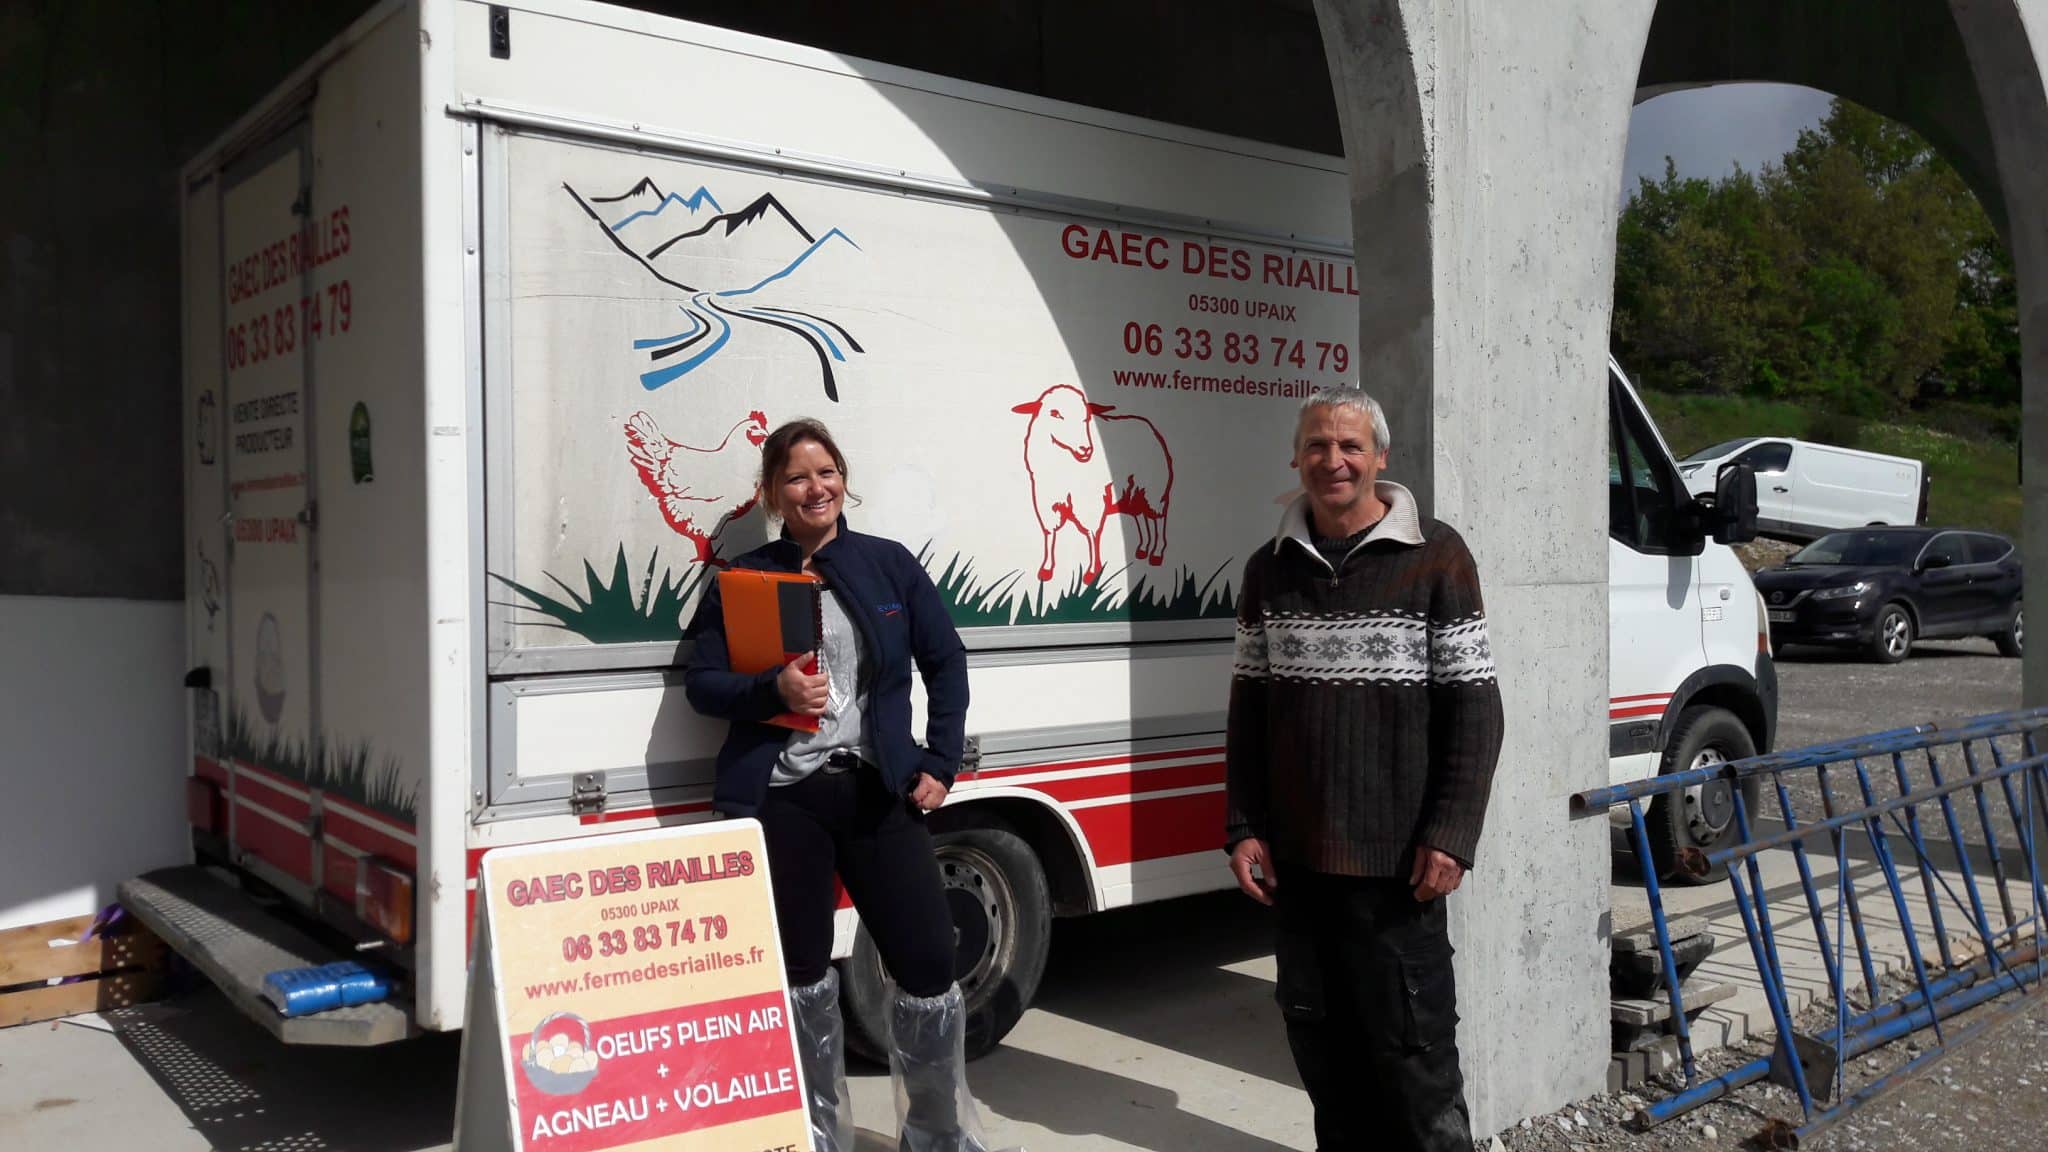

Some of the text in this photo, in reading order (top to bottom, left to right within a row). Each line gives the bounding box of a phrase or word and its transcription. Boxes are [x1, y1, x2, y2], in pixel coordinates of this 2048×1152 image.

[228, 253, 261, 304] GAEC
[262, 240, 288, 290] DES
[1061, 224, 1169, 270] GAEC
[1183, 242, 1251, 281] DES
[227, 280, 351, 370] 06 33 83 74 79
[1188, 294, 1297, 322] 05300 UPAIX
[1123, 321, 1349, 373] 06 33 83 74 79
[1113, 370, 1347, 399] www.fermedesriaille
[507, 851, 755, 907] GAEC DES RIAILLES
[601, 899, 680, 921] 05300 UPAIX
[562, 915, 728, 963] 06 33 83 74 79
[524, 946, 765, 999] www.fermedesriailles.fr
[597, 1006, 783, 1060] OEUFS PLEIN AIR
[656, 1063, 670, 1078] +
[531, 1068, 794, 1140] AGNEAU + VOLAILLE
